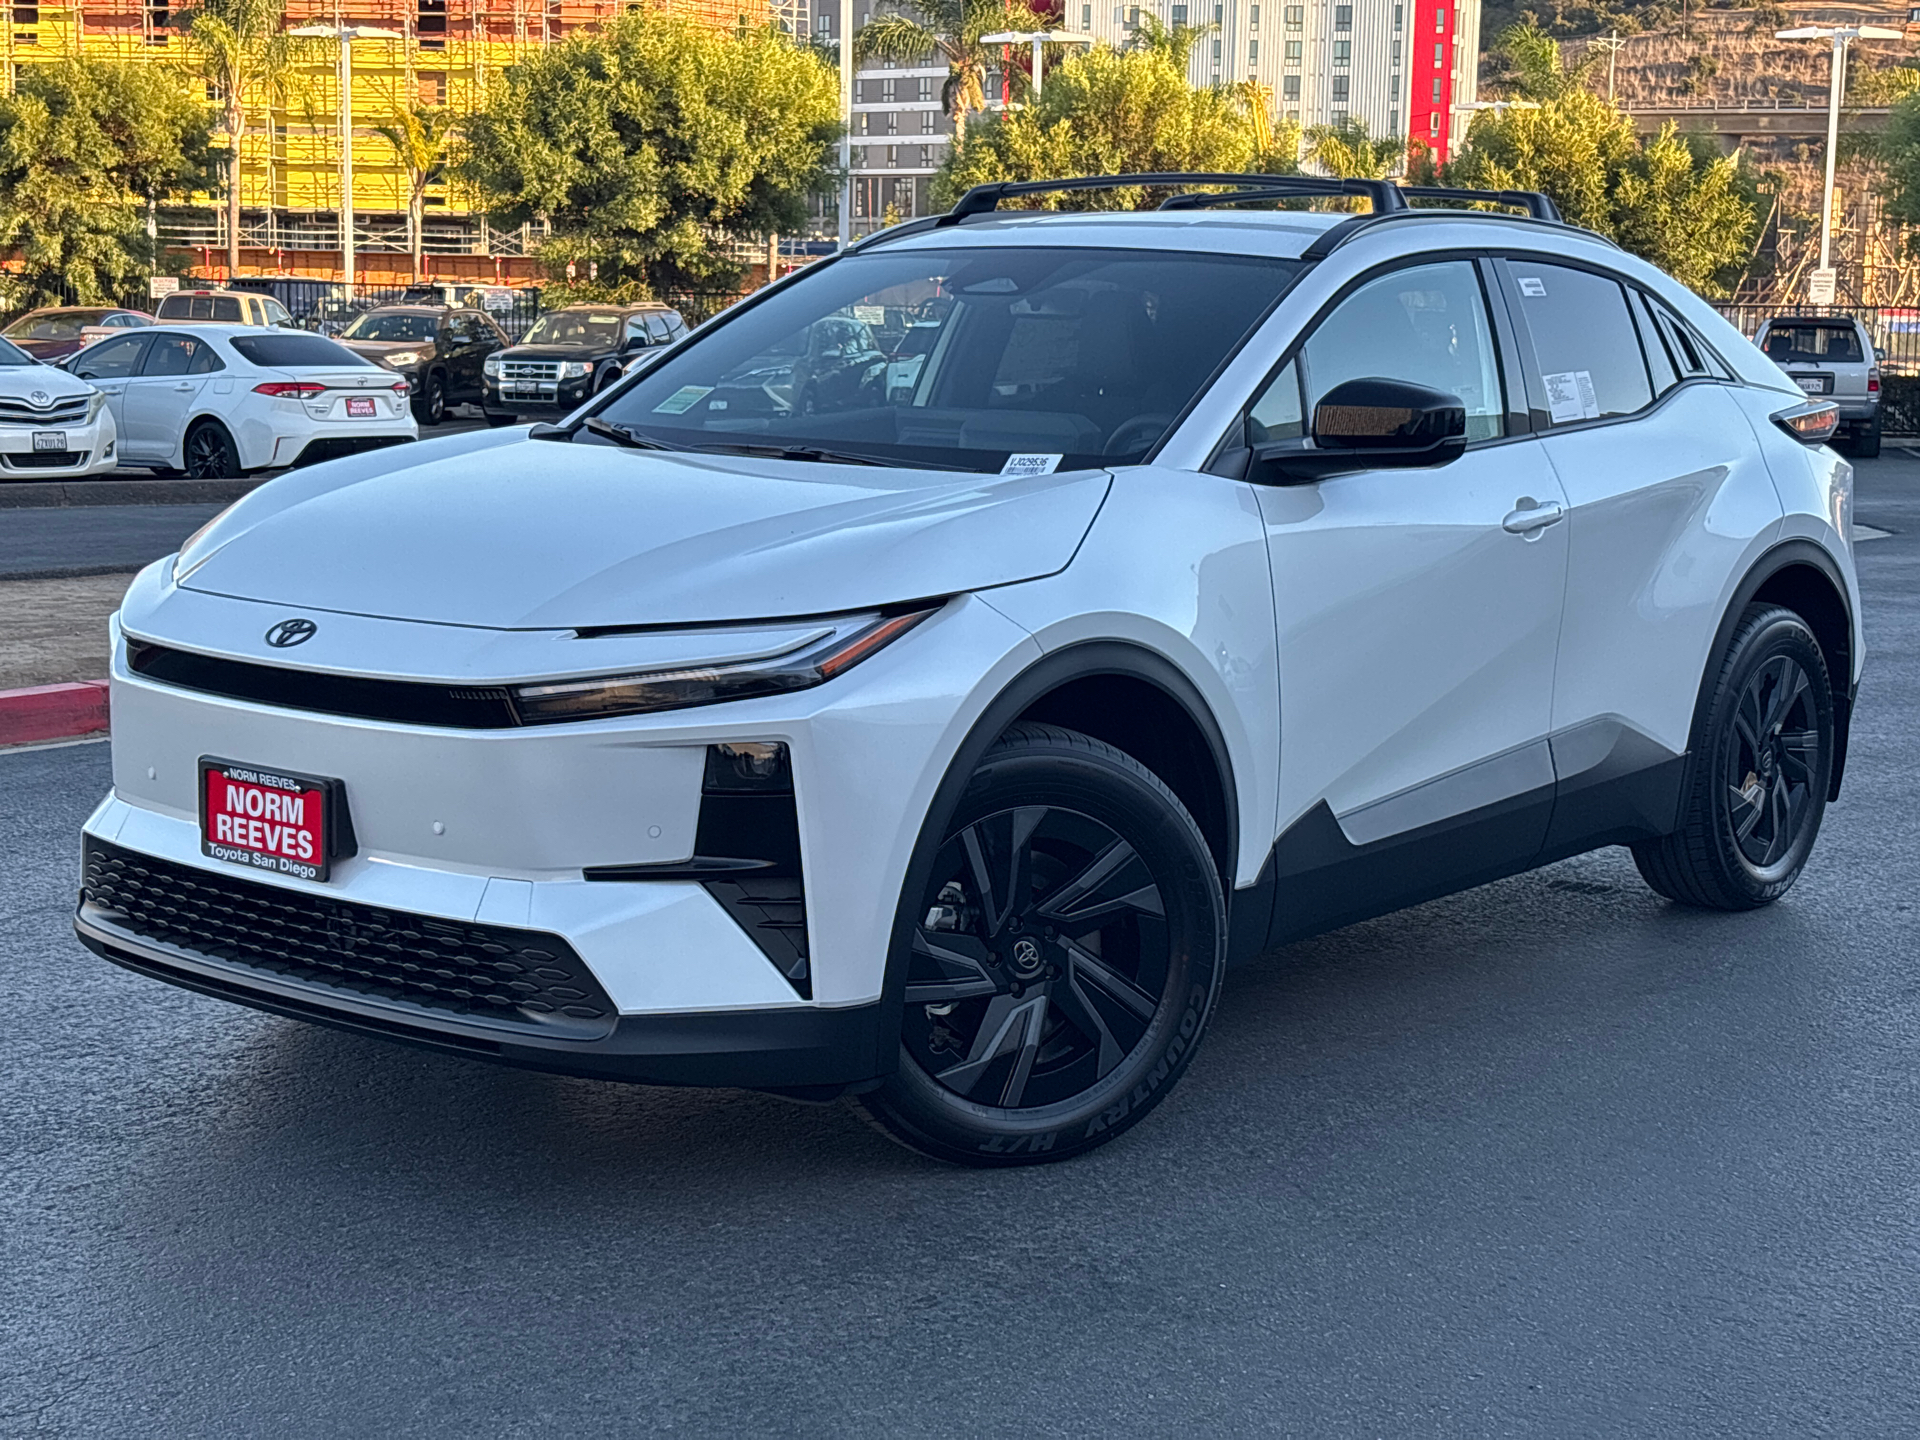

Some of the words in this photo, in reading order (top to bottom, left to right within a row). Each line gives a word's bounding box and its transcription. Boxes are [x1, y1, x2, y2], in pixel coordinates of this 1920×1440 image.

[229, 768, 258, 784] NORM
[259, 773, 295, 790] REEVES
[226, 785, 304, 826] NORM
[216, 813, 313, 859] REEVES
[208, 842, 249, 863] Toyota
[252, 852, 276, 869] San
[280, 858, 316, 879] Diego
[1761, 867, 1799, 898] OPEN
[1084, 982, 1207, 1139] COUNTRY
[978, 1131, 1059, 1153] H/T
